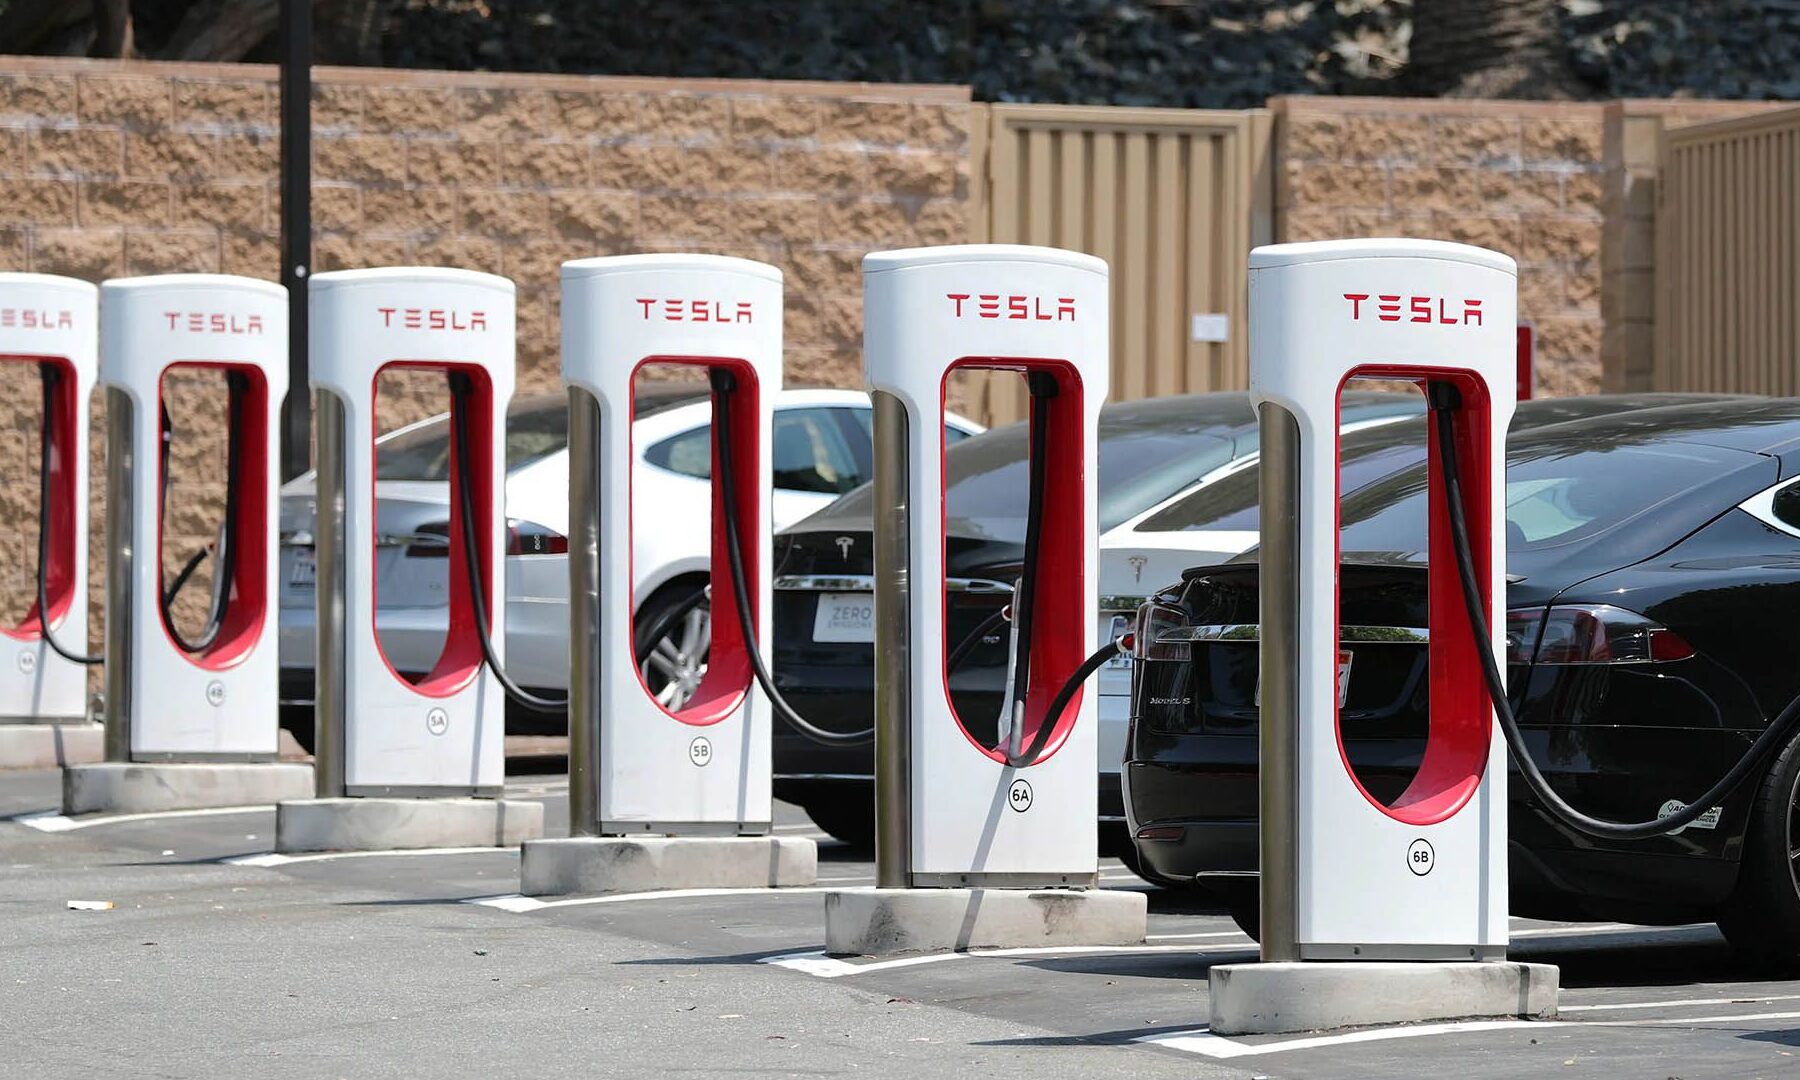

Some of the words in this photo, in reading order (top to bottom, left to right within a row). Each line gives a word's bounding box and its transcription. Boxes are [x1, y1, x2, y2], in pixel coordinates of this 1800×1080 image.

[637, 298, 753, 323] TESLA
[947, 293, 1076, 321] TESLA
[1344, 293, 1483, 326] TESLA
[1, 308, 73, 330] ESLA
[167, 311, 263, 334] TESLA
[379, 308, 487, 332] TESLA
[832, 606, 872, 620] ZERO
[431, 715, 445, 726] 5A
[694, 745, 708, 757] 5B
[1012, 788, 1030, 802] 6A
[1413, 850, 1429, 863] 6B
